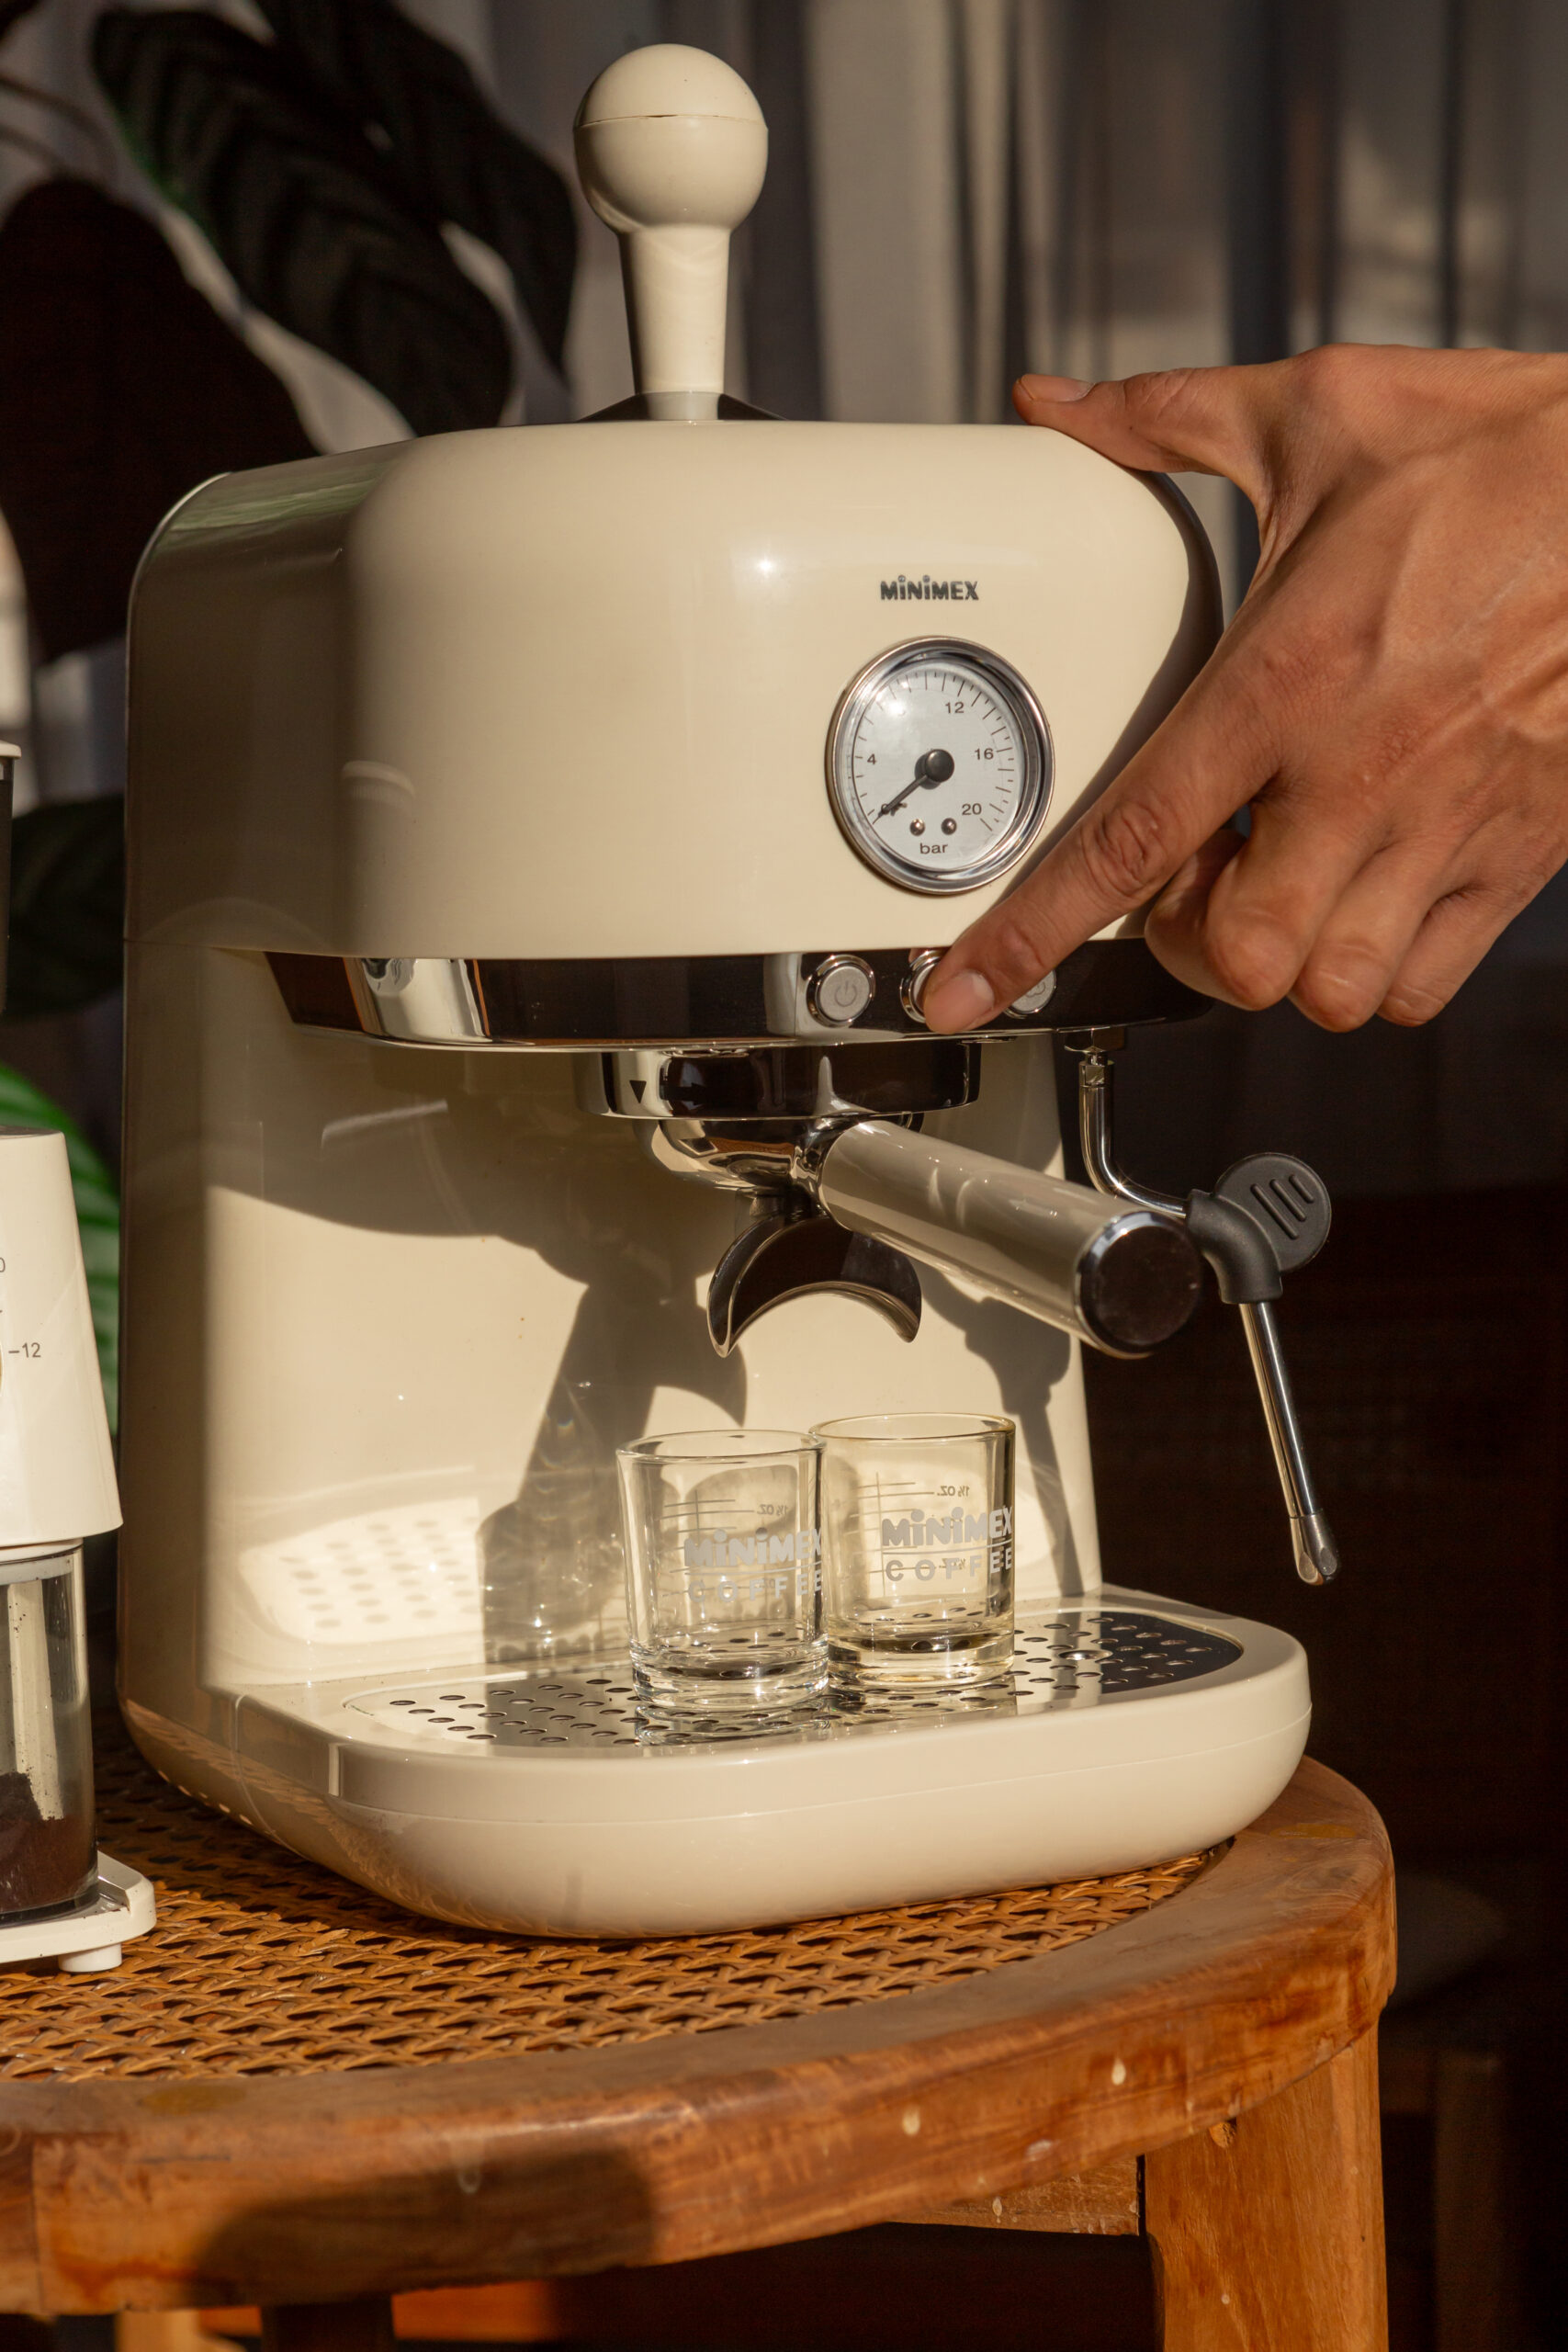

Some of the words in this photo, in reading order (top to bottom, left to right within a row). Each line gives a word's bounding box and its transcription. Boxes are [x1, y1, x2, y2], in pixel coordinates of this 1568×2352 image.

[945, 701, 964, 714] 12
[867, 753, 877, 765] 4
[975, 748, 994, 761] 16
[961, 802, 983, 816] 20
[919, 842, 949, 855] bar
[886, 1547, 1012, 1581] COFFEE
[689, 1569, 821, 1602] COFFEE
